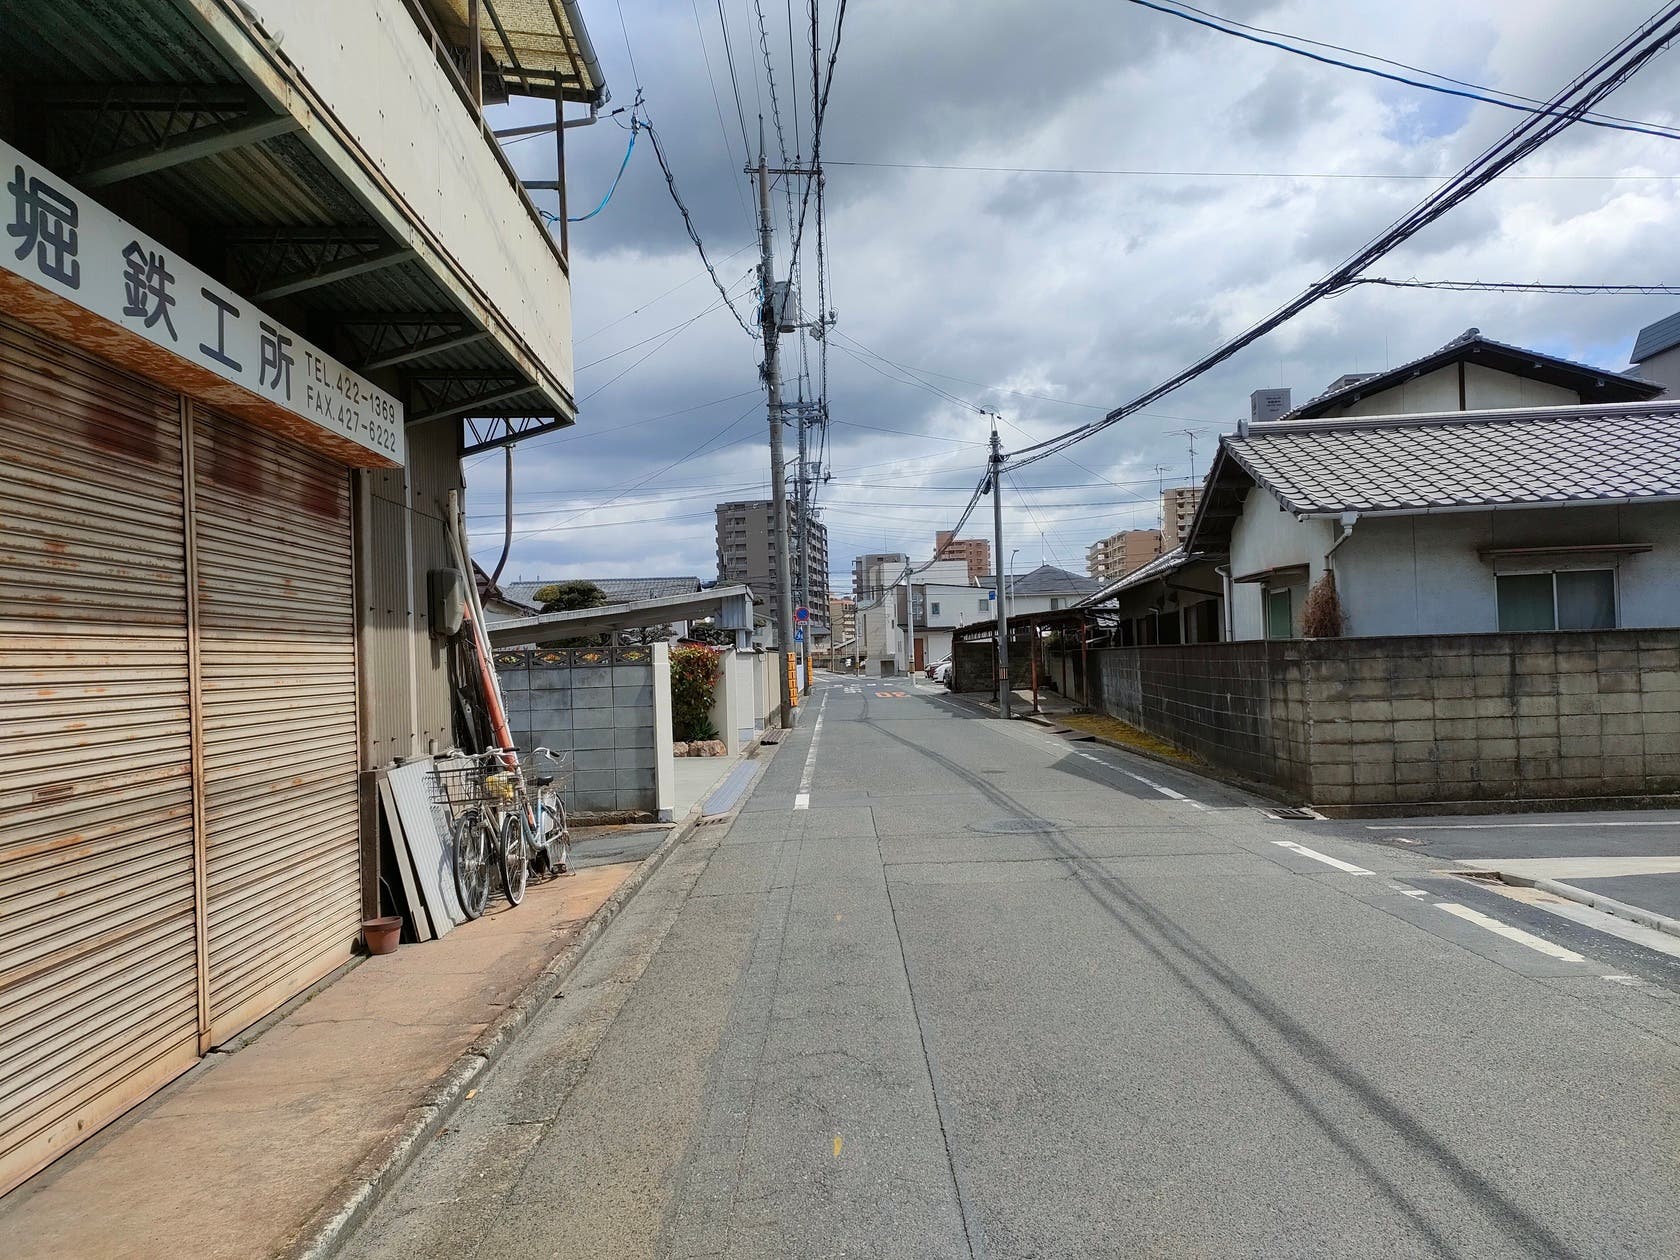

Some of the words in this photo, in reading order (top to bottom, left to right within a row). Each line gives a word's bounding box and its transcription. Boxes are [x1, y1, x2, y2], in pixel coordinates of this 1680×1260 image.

[7, 165, 295, 401] 堀鉄工所
[305, 350, 395, 425] TEL.422-1369
[306, 384, 396, 453] FAX.427-6222
